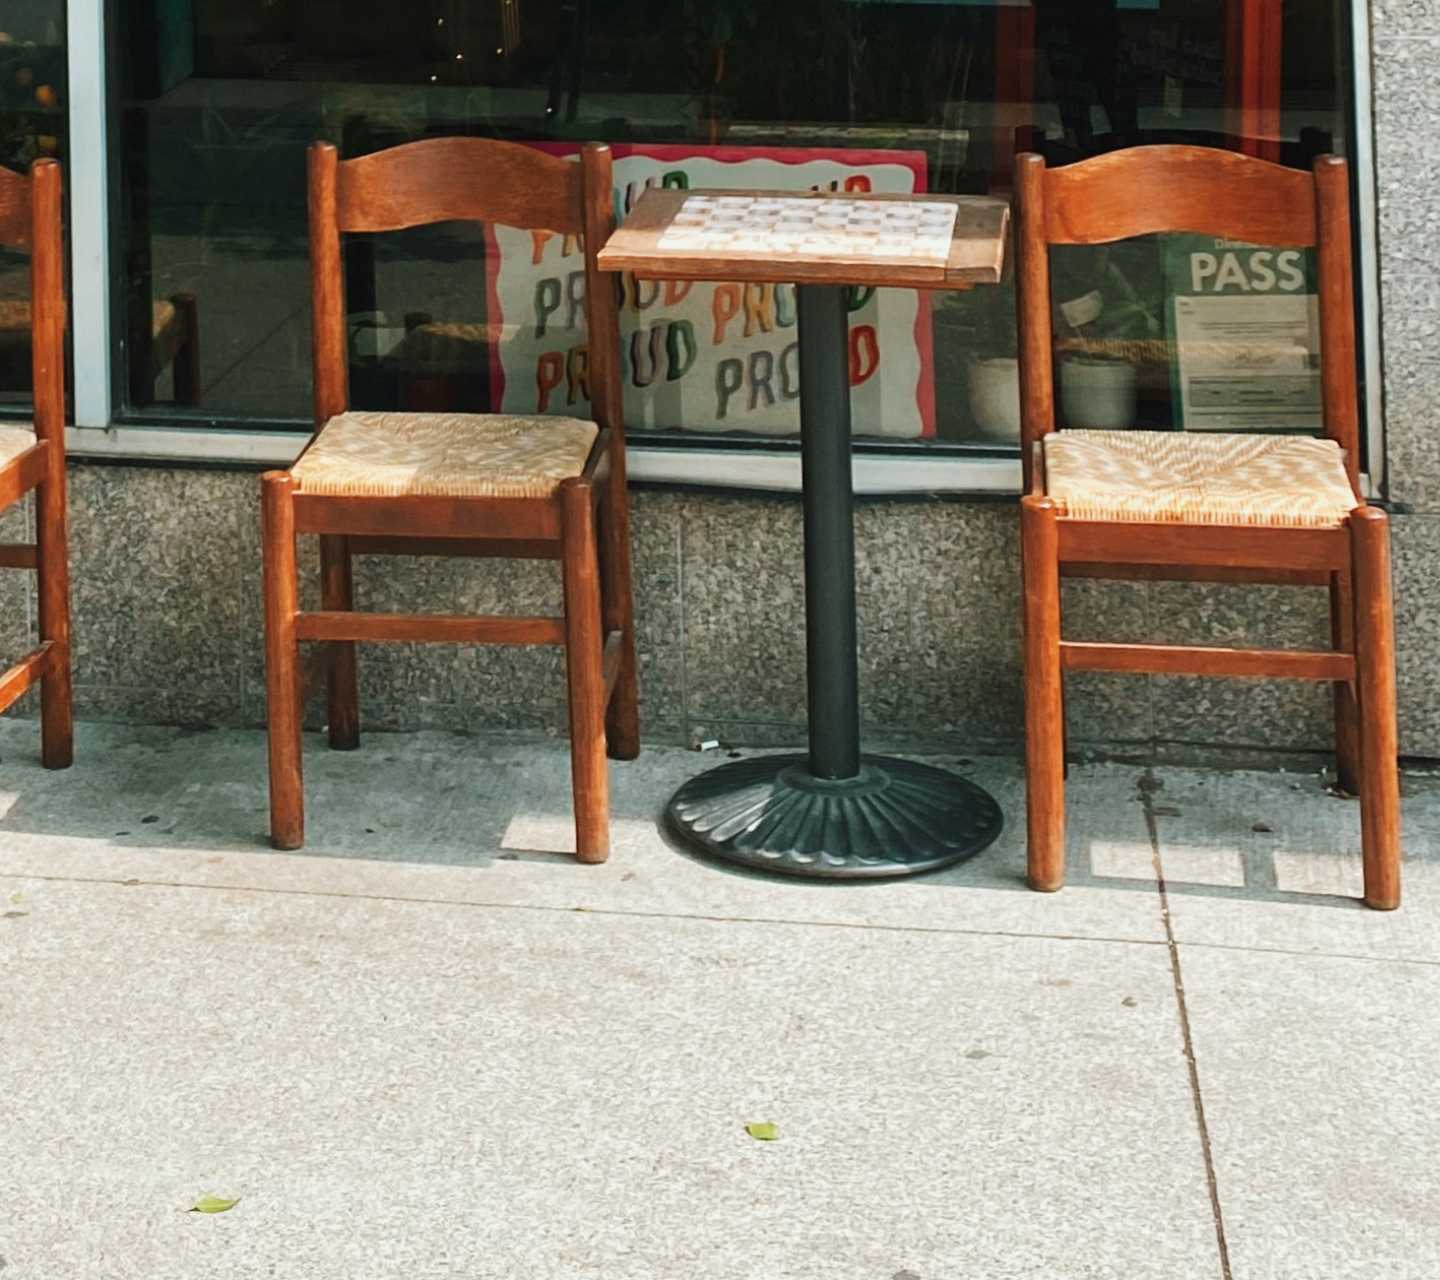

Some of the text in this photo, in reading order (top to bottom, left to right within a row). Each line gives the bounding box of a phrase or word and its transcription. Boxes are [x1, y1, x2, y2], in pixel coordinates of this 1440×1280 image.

[1190, 250, 1304, 291] PASS
[537, 319, 880, 420] PRUD PROD
